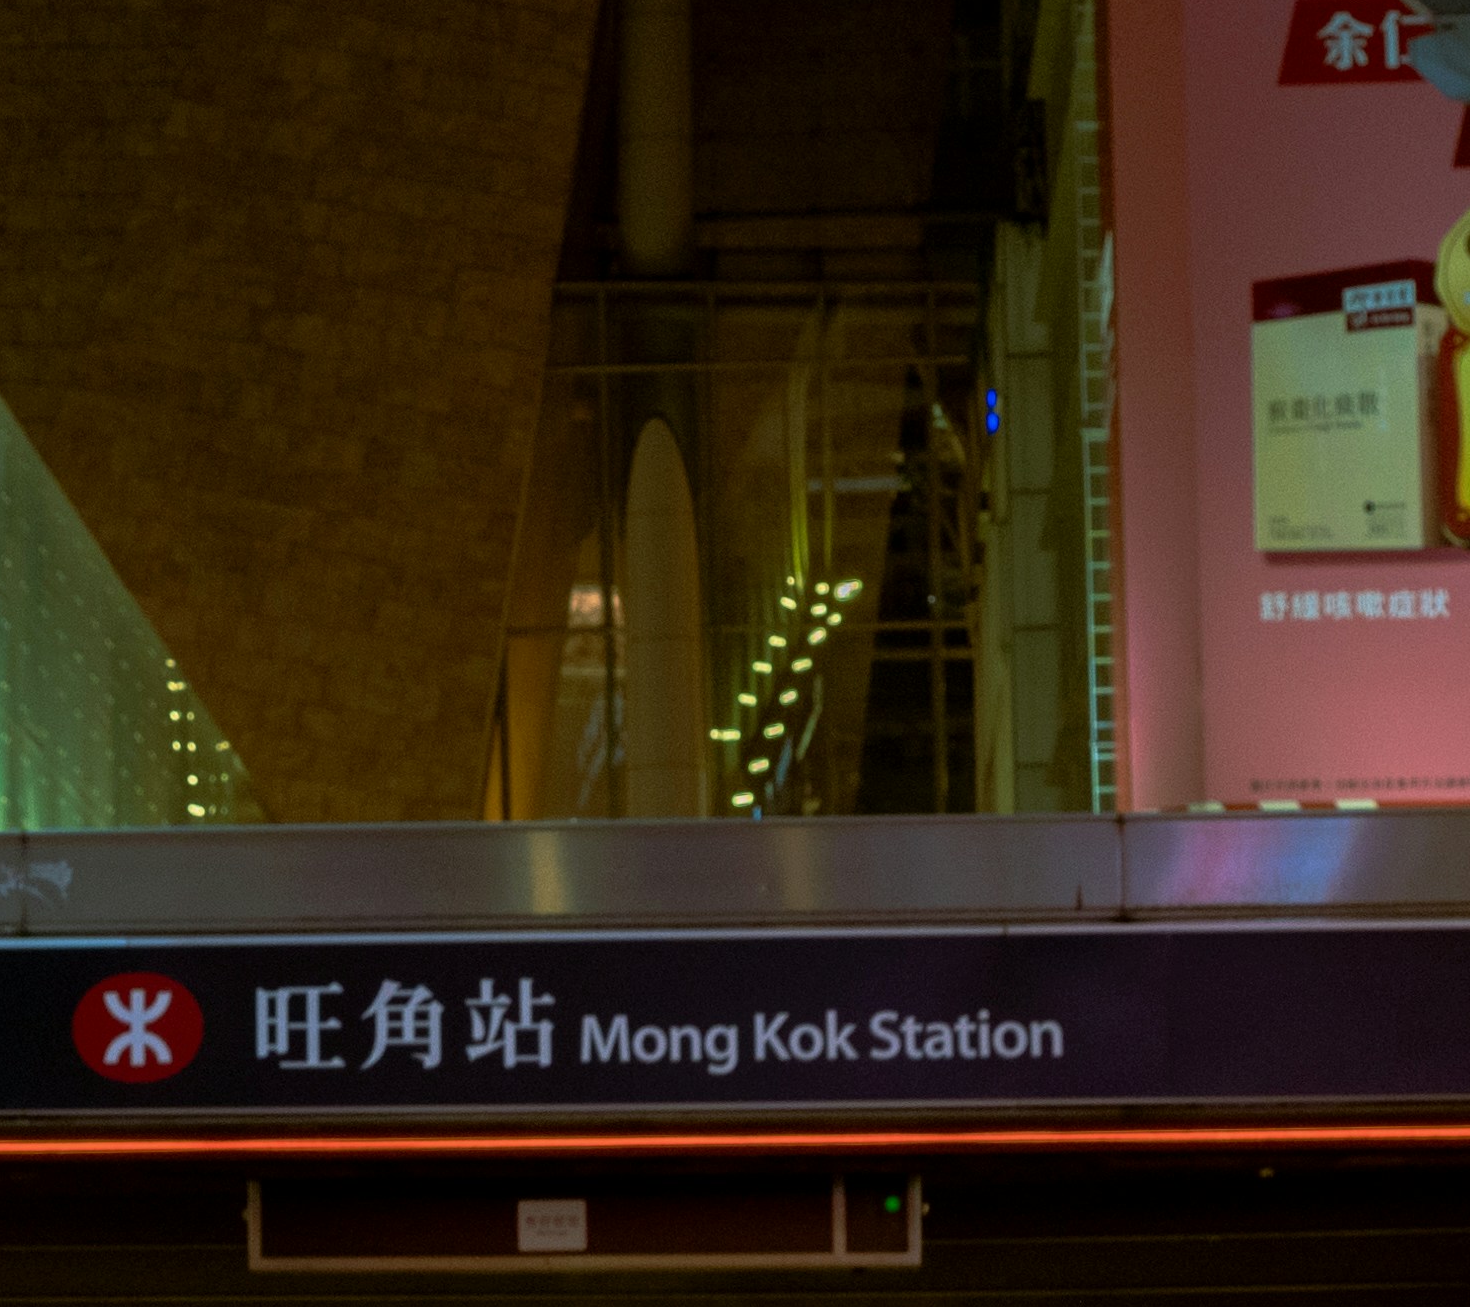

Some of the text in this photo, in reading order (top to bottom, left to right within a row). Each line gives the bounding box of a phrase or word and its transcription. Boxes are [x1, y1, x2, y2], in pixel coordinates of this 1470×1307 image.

[255, 978, 1064, 1076] 旺角站 Mong Kok Station
